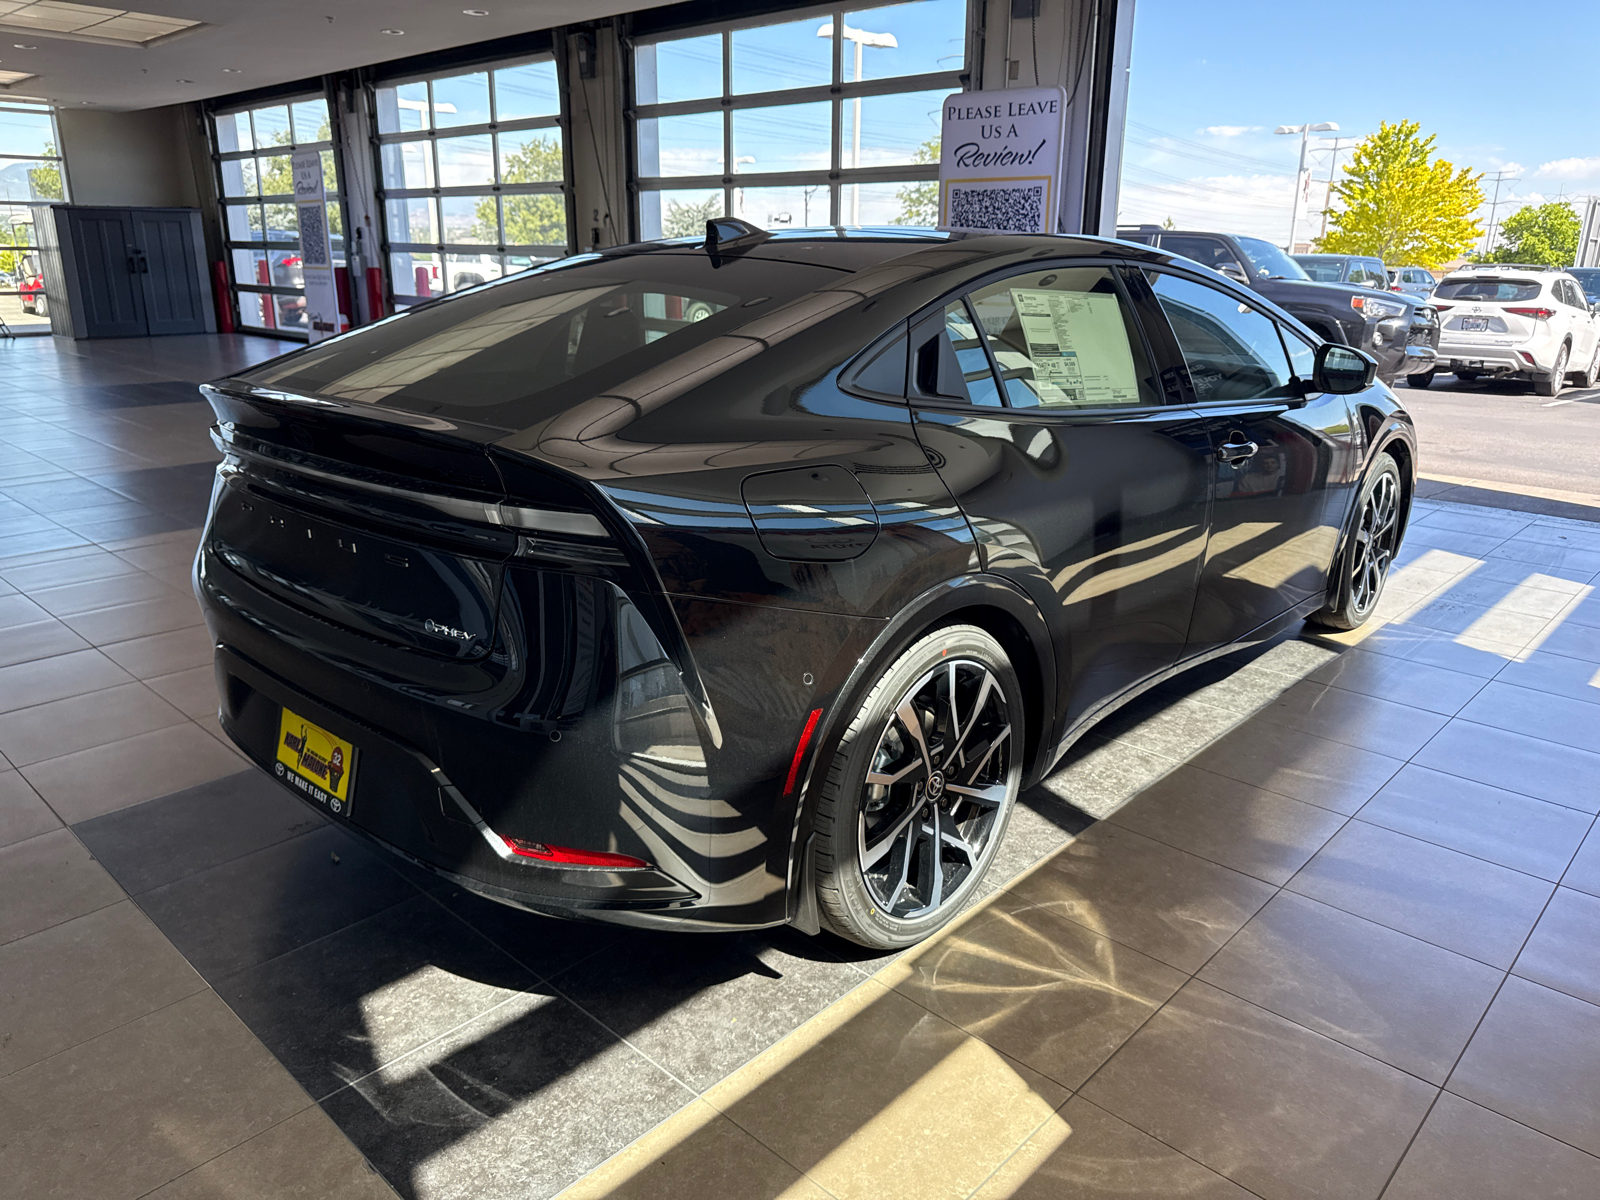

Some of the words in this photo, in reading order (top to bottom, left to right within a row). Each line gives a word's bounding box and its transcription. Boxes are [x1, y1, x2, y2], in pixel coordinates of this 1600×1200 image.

[948, 105, 1002, 121] PLEASE
[1008, 100, 1058, 117] LEAVE
[1006, 123, 1019, 138] A
[953, 138, 1047, 168] Review!
[332, 752, 341, 766] 32
[286, 770, 295, 783] WE
[294, 774, 309, 792] MAKE
[308, 784, 315, 795] IT
[313, 788, 328, 804] EASY
